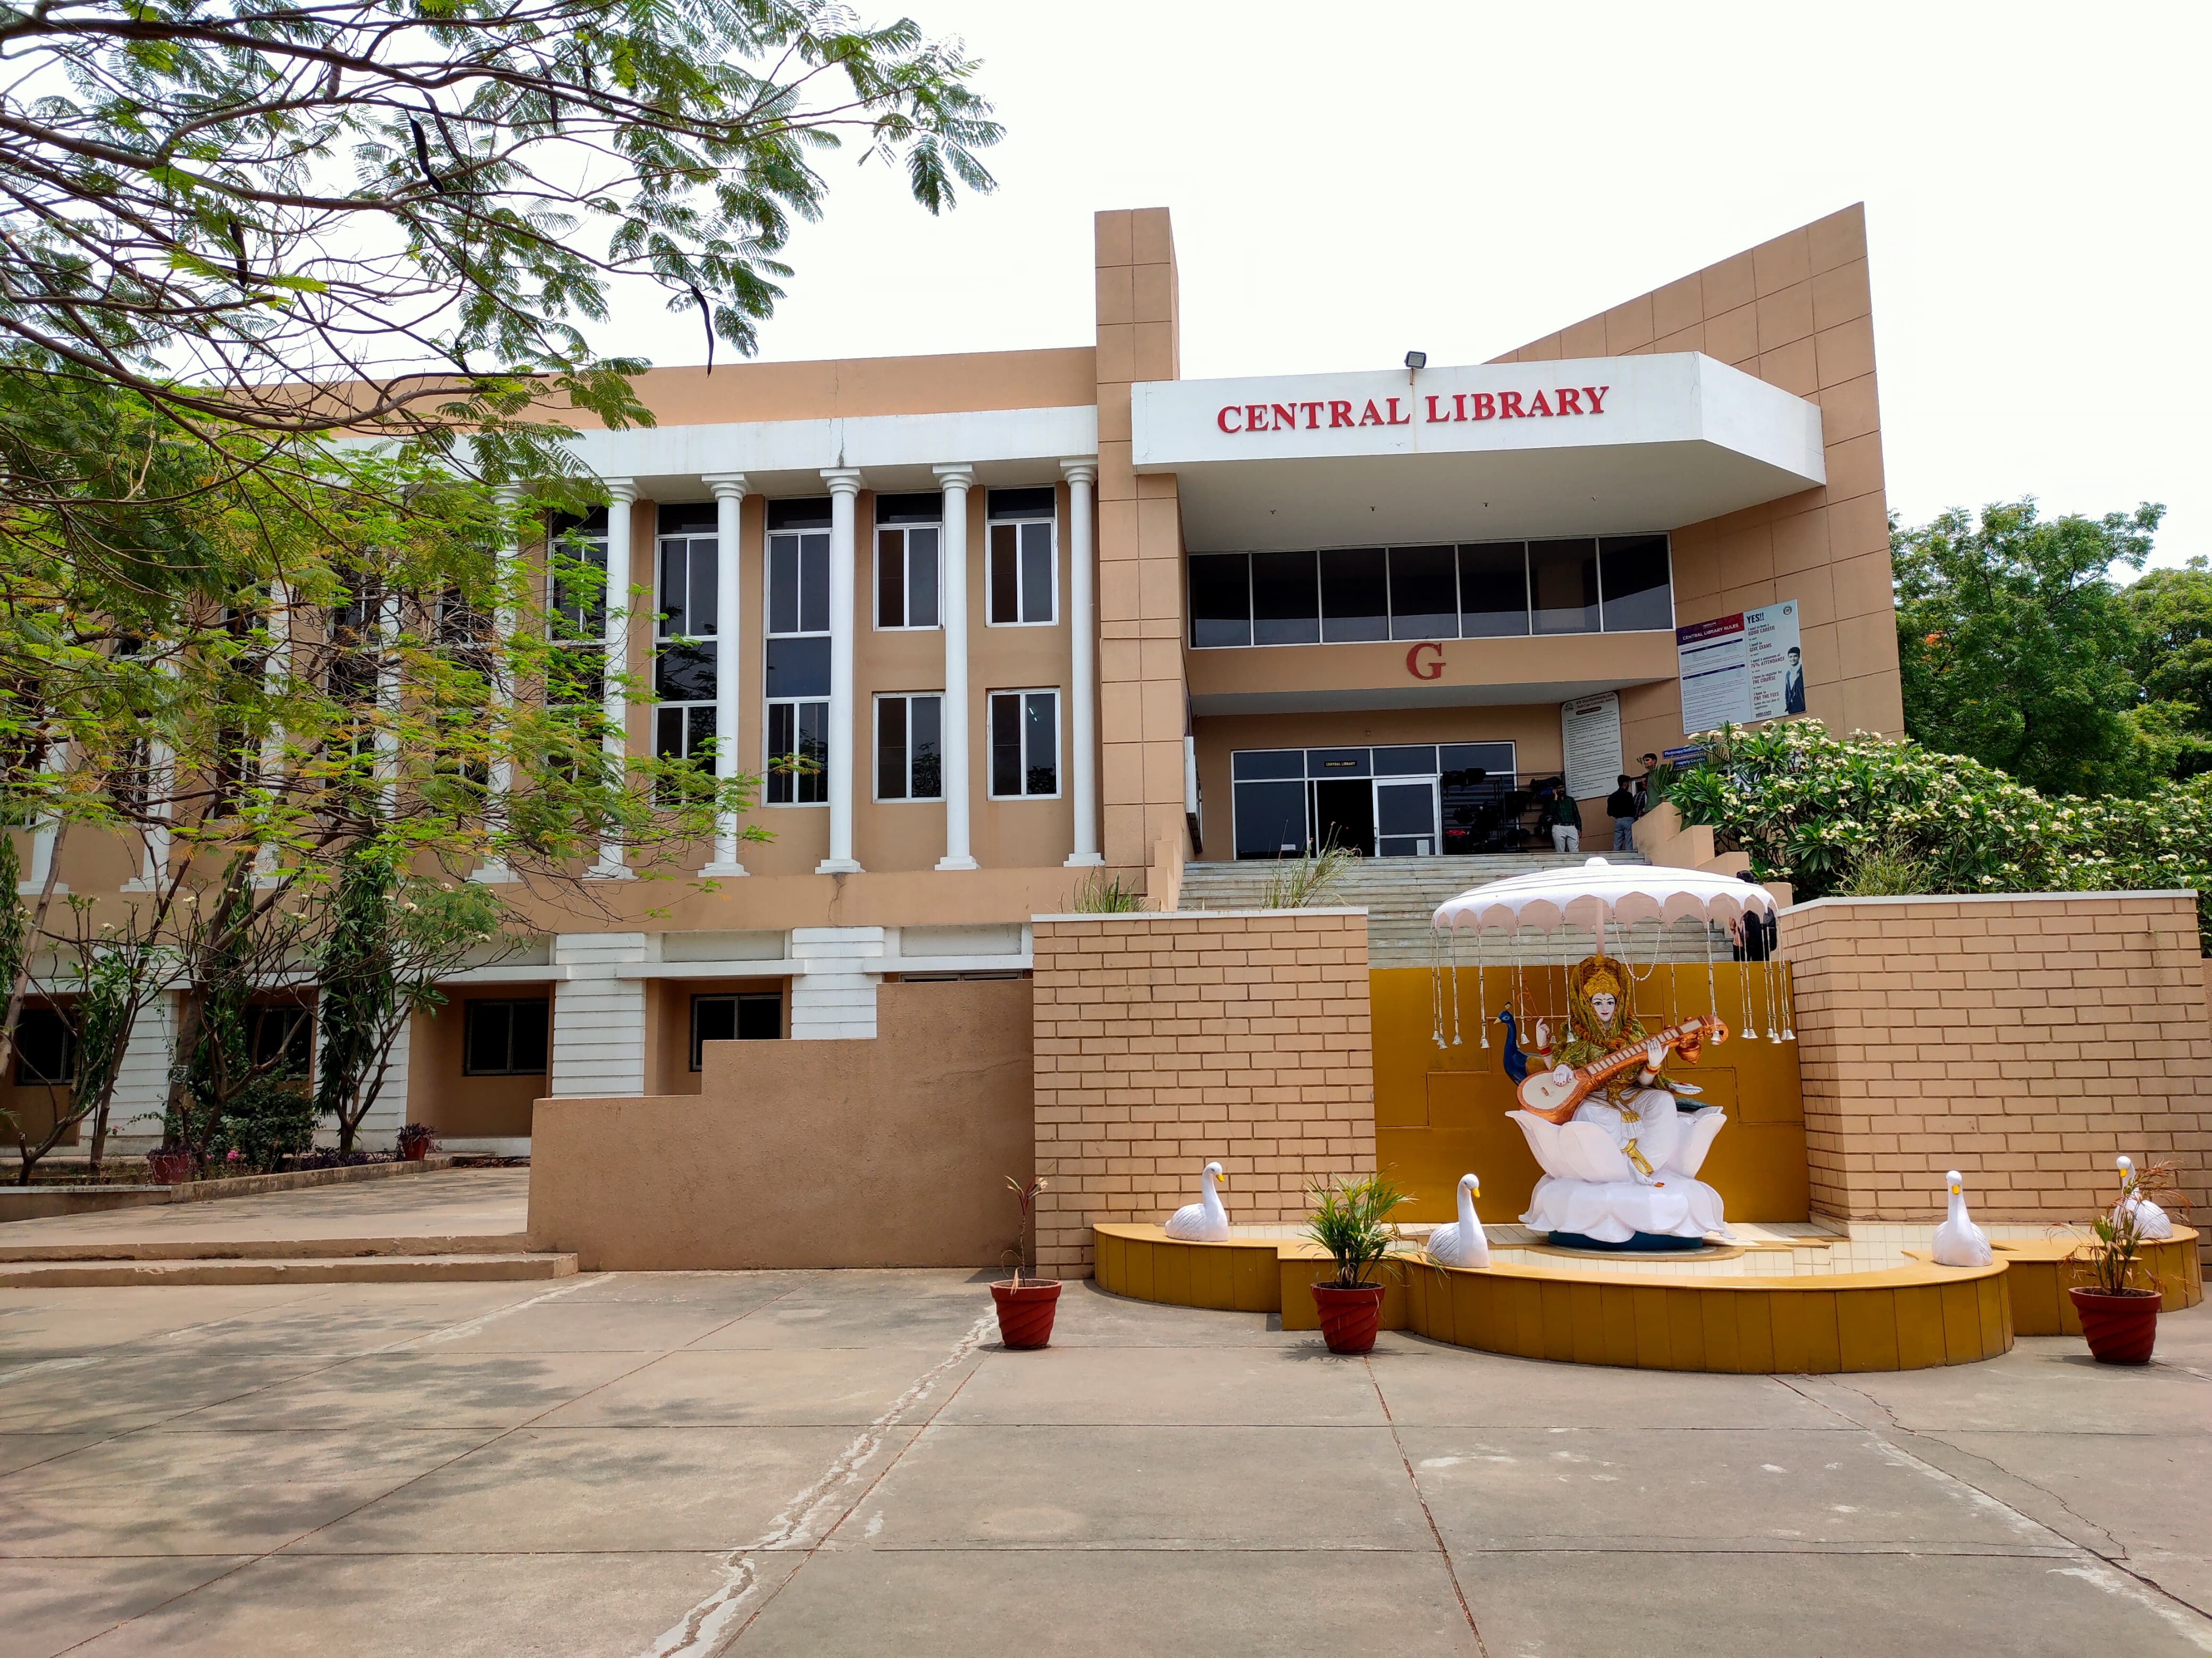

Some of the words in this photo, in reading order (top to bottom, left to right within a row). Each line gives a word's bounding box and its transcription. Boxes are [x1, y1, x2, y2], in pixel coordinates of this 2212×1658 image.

[1218, 398, 1410, 433] CENTRAL
[1425, 386, 1610, 423] LIBRARY
[1406, 643, 1446, 680] G
[1761, 656, 1784, 666] ATTENDANCE
